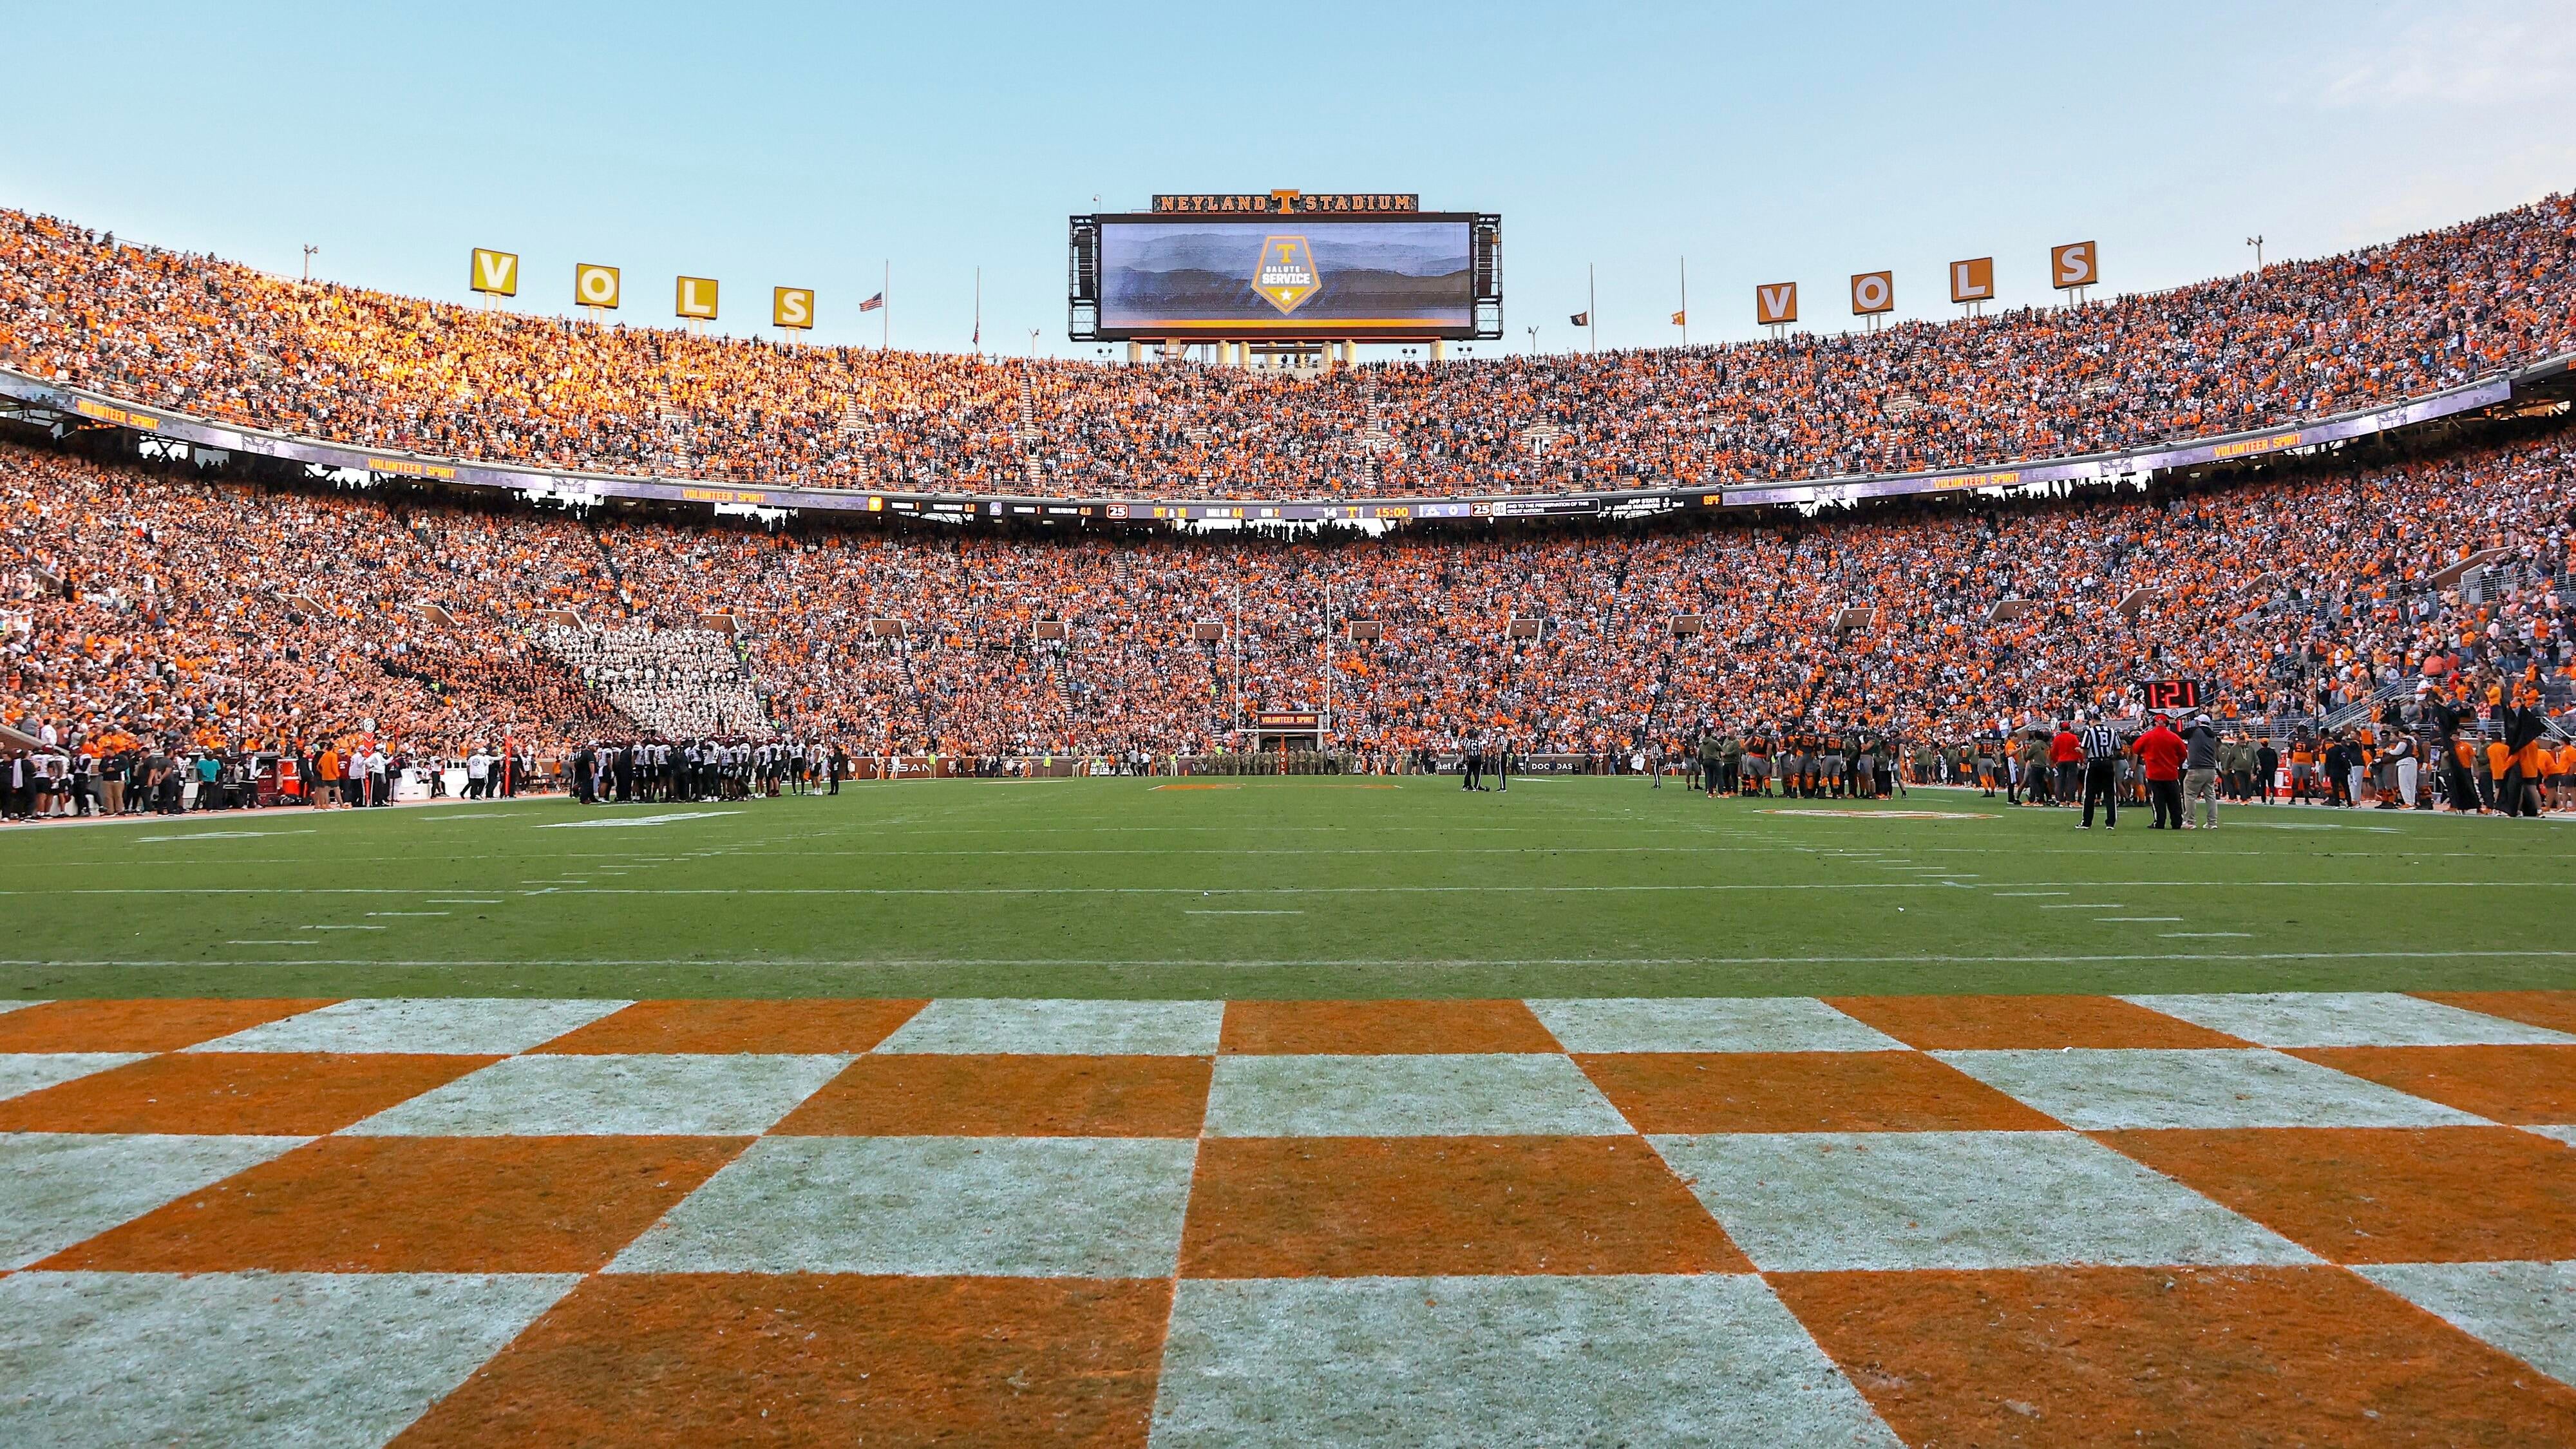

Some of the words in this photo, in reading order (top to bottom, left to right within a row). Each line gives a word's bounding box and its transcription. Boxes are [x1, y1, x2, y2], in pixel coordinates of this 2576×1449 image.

[1161, 196, 1266, 211] NEYLAND
[1271, 189, 1300, 214] T
[1305, 195, 1410, 210] STADIUM
[1276, 243, 1296, 263] T
[1262, 273, 1311, 284] SERVICE
[77, 400, 127, 424] VOLUNTEER
[129, 413, 160, 430] SPIRIT
[2214, 439, 2269, 457] VOLUNTEER
[2273, 433, 2302, 448] SPIRIT
[368, 457, 422, 475] VOLUNTEER
[426, 466, 456, 478] SPIRIT
[1933, 475, 1987, 489] VOLUNTEER
[1990, 472, 2020, 484] SPIRIT
[682, 489, 734, 501] VOLUNTEER
[737, 492, 766, 503] SPIRIT
[965, 504, 975, 512] 0.0
[1079, 507, 1091, 515] 41.0
[1109, 507, 1126, 516] 25
[1153, 507, 1166, 518] 1ST
[1168, 508, 1175, 518] &
[1177, 507, 1186, 518] 10
[1231, 507, 1244, 518] 44
[1274, 507, 1280, 518] 2
[1322, 507, 1338, 518] 14
[1345, 506, 1359, 518] T
[1375, 507, 1409, 518] 15:00
[1448, 504, 1459, 516] 0
[1473, 504, 1490, 515] 25
[1495, 505, 1504, 513] CC
[2149, 681, 2195, 708] 1:21
[2098, 732, 2108, 746] B
[1983, 744, 1993, 754] 12
[869, 763, 931, 772] NSSAN
